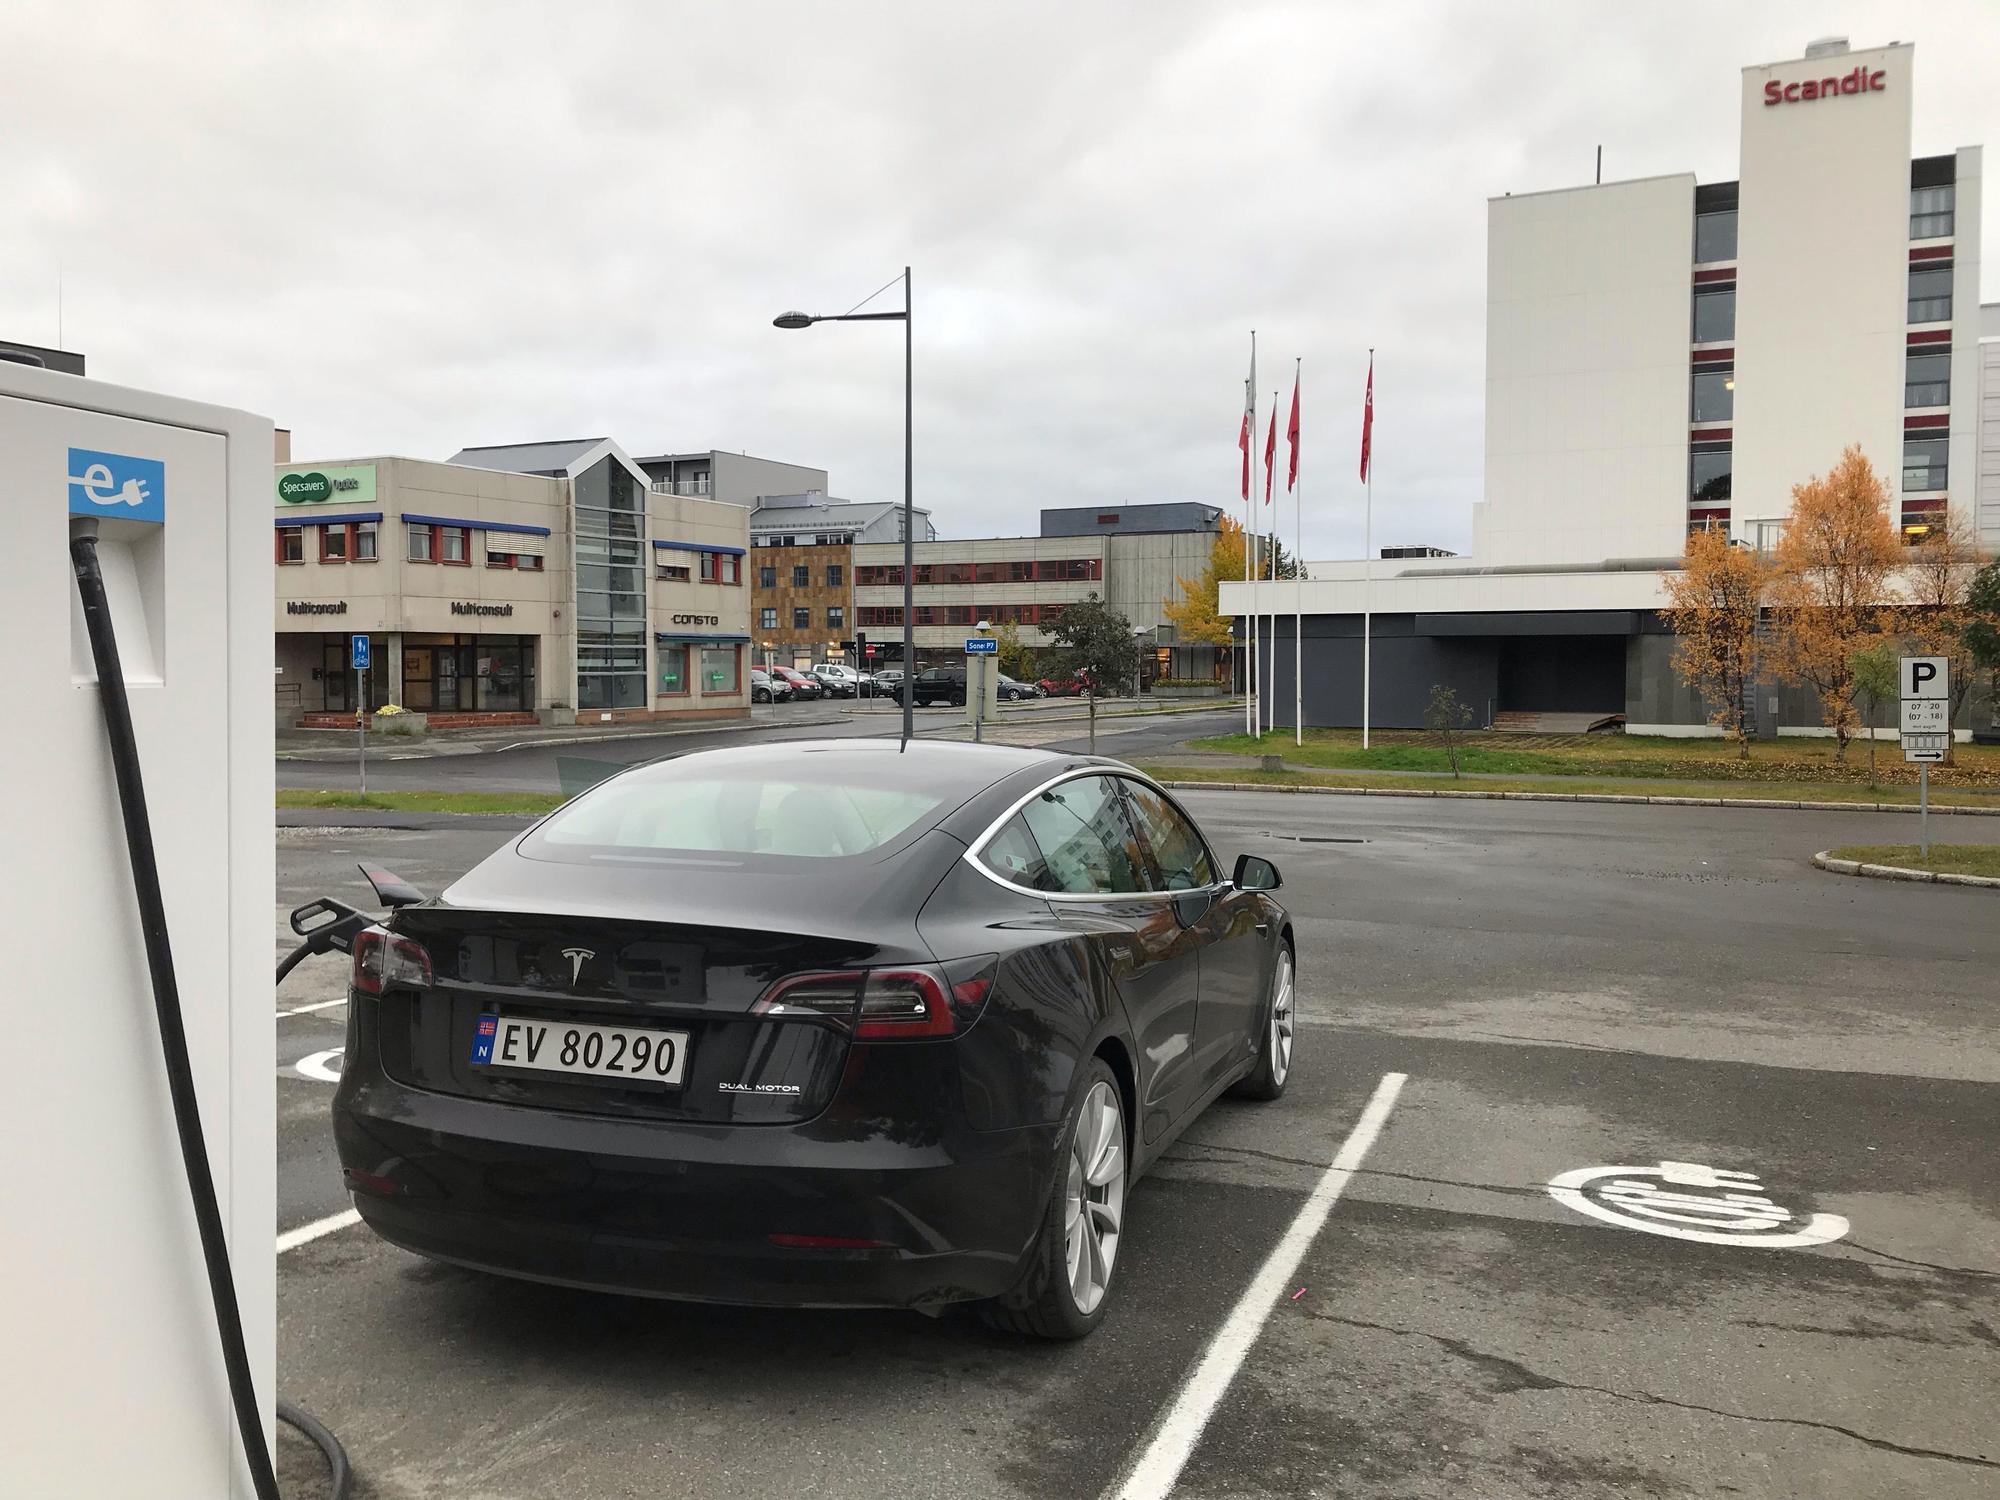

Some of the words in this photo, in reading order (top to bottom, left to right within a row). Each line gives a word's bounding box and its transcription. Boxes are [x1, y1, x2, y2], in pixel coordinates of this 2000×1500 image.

[1764, 65, 1887, 107] Scandic
[283, 481, 325, 495] Specsavers
[286, 600, 348, 615] Multiconsult
[450, 601, 514, 617] Multiconsult
[1912, 662, 1937, 694] P
[1911, 703, 1921, 711] 07
[1908, 712, 1921, 721] (07
[1930, 712, 1943, 720] 18)
[478, 1046, 488, 1057] N
[501, 1024, 547, 1063] EV
[559, 1029, 676, 1076] 80290
[719, 1082, 753, 1090] DUAL
[755, 1084, 801, 1092] MOTOR
